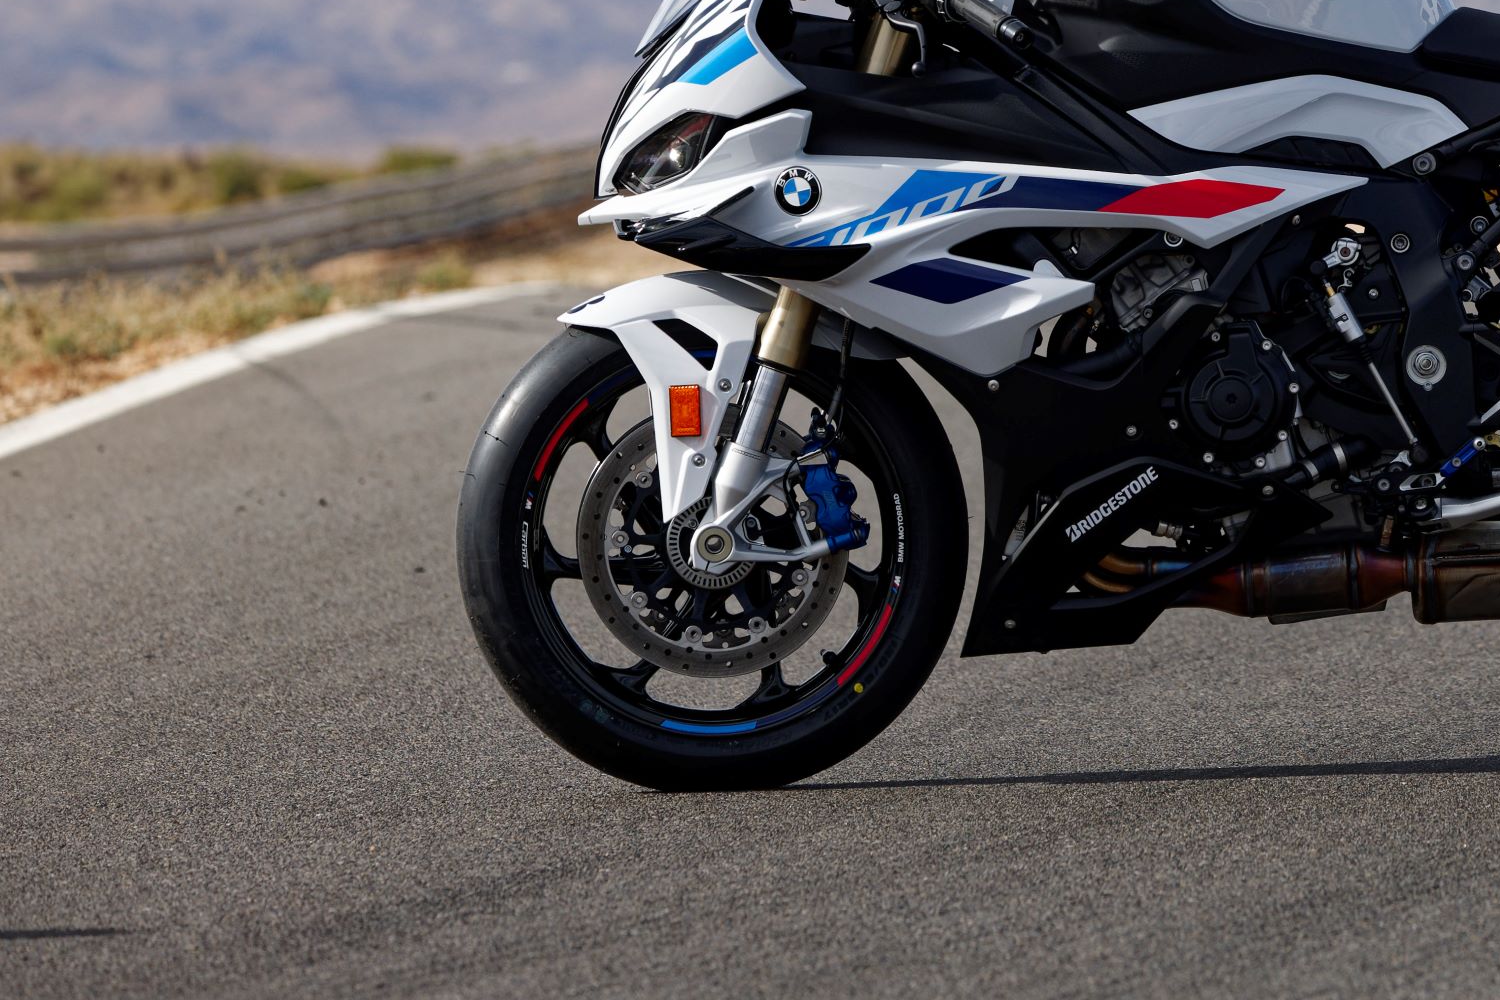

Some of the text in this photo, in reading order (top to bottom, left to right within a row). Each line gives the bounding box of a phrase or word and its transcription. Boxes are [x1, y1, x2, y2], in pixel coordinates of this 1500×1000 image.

[776, 169, 814, 187] BMW
[893, 493, 905, 563] BMW MOTORRAD
[1065, 466, 1159, 543] BRIDGESTONE
